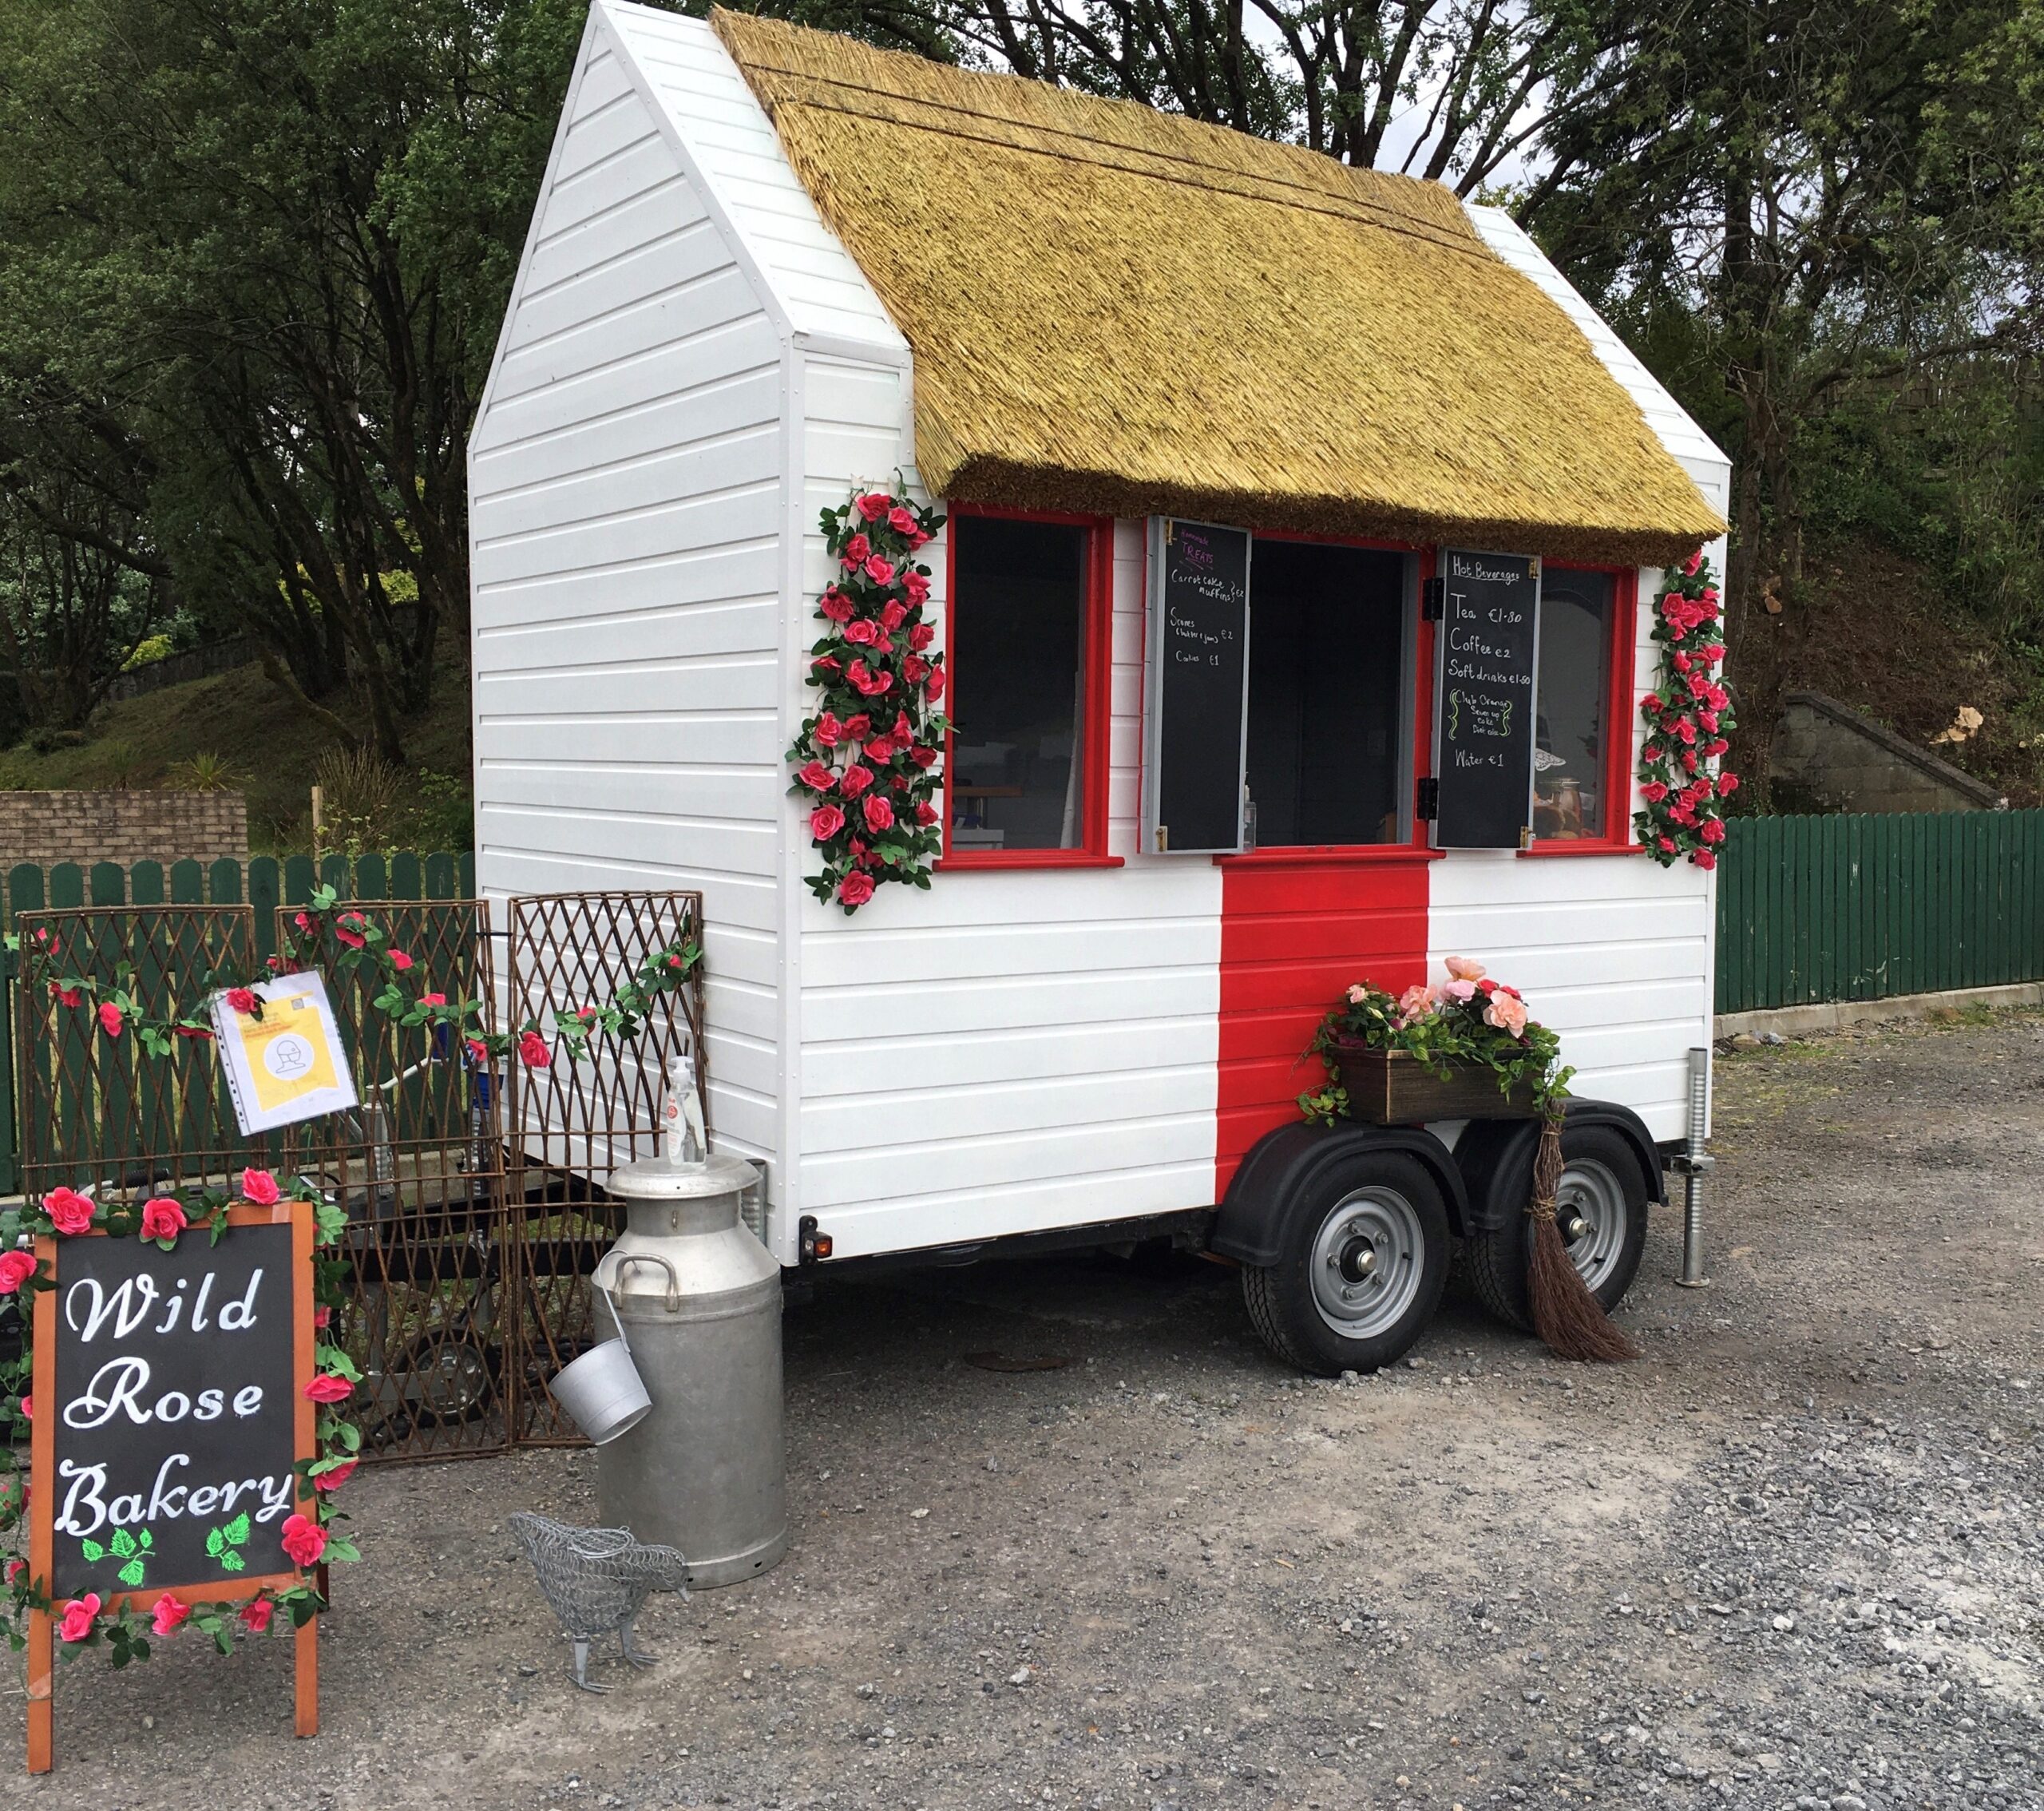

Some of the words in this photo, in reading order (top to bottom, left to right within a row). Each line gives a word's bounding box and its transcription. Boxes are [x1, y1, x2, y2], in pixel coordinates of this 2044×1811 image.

[1182, 541, 1214, 564] TREATS
[1171, 569, 1201, 585] Carrot
[1453, 555, 1472, 576] Hot
[1475, 561, 1519, 585] Beverages
[1170, 606, 1195, 628] Scones
[1450, 592, 1476, 619] Tea
[1488, 608, 1522, 623] €1.80
[1450, 627, 1491, 654] Coffee
[1495, 648, 1511, 658] €2
[1448, 659, 1475, 679] Soft
[1476, 666, 1507, 683] drinks
[1508, 674, 1531, 684] €1.50
[1455, 689, 1477, 706] Club
[1479, 694, 1508, 712] Orange
[1470, 705, 1490, 716] Seven
[1472, 724, 1486, 734] Diet
[1456, 749, 1483, 767] Water
[1487, 753, 1504, 767] €1
[65, 1268, 263, 1342] Wild
[63, 1356, 263, 1429] Rose
[53, 1453, 294, 1537] Bakery
